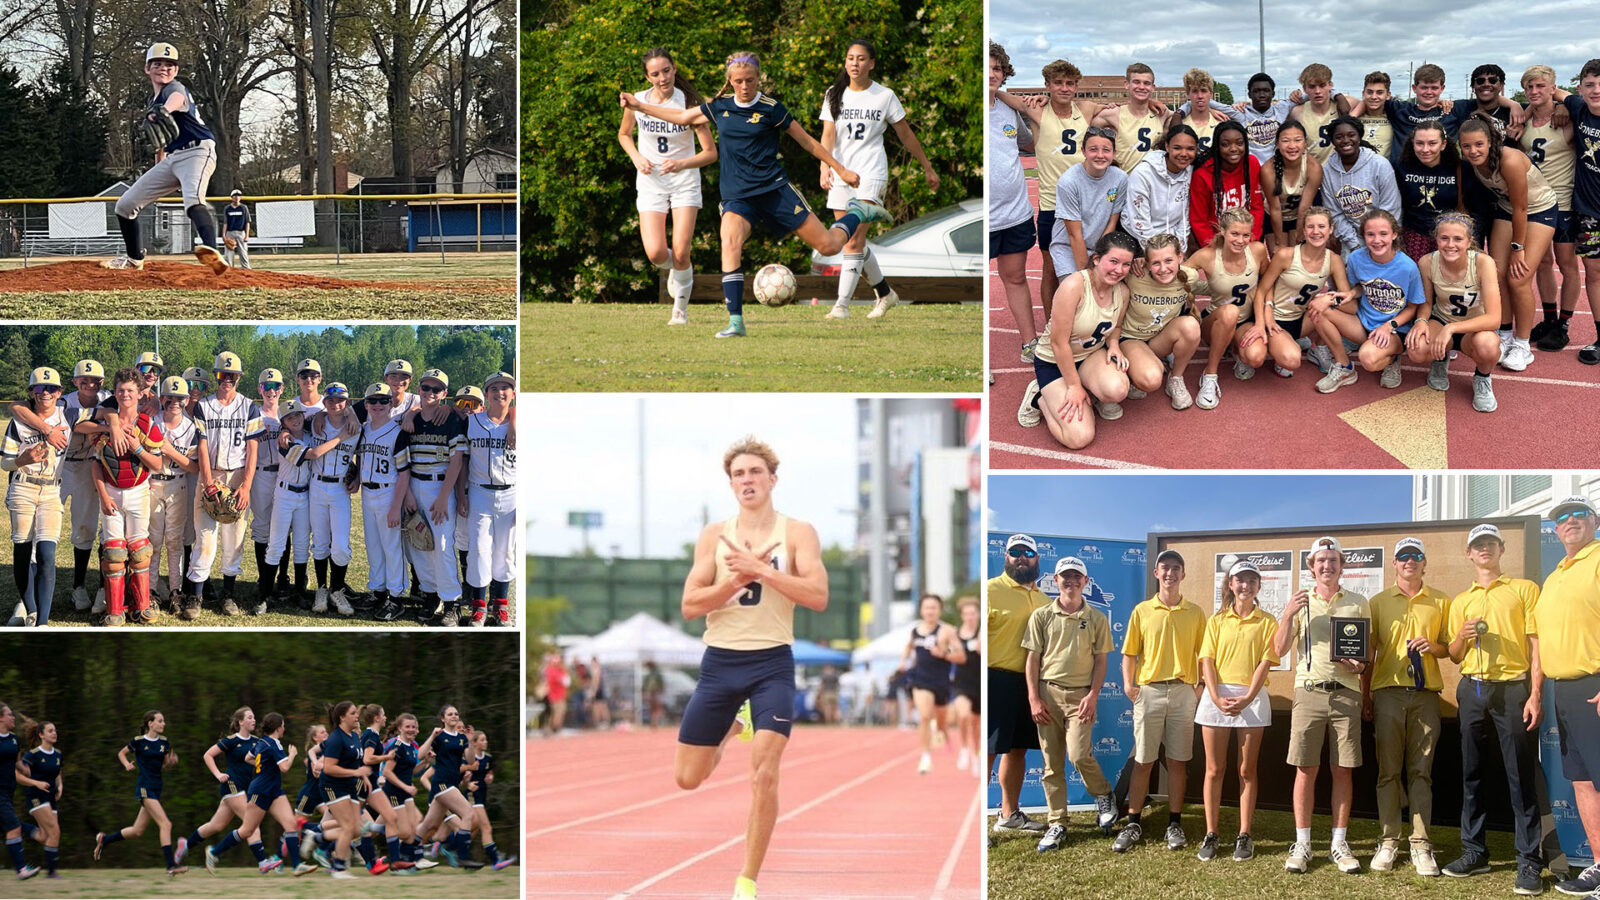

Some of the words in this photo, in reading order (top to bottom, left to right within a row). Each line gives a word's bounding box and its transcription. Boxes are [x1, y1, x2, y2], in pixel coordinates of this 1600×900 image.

[163, 46, 171, 56] S
[838, 108, 882, 122] MBERLAKE
[657, 136, 668, 153] 8
[1061, 129, 1077, 155] S
[1137, 127, 1151, 152] S
[1532, 138, 1547, 163] S
[1231, 284, 1250, 306] S
[1294, 284, 1318, 305] S
[1468, 292, 1478, 307] 7
[1449, 295, 1468, 316] S
[1083, 321, 1112, 349] S
[85, 363, 92, 372] S
[225, 357, 232, 367] S
[397, 361, 404, 369] S
[43, 370, 50, 380] S
[195, 368, 201, 377] S
[268, 371, 274, 379] S
[433, 369, 440, 377] S
[172, 381, 179, 391] S
[464, 386, 471, 394] S
[287, 401, 294, 410] S
[233, 431, 242, 446] 6
[342, 455, 349, 466] 9
[375, 457, 389, 474] 13
[1343, 552, 1375, 564] tleist
[1079, 620, 1087, 629] S
